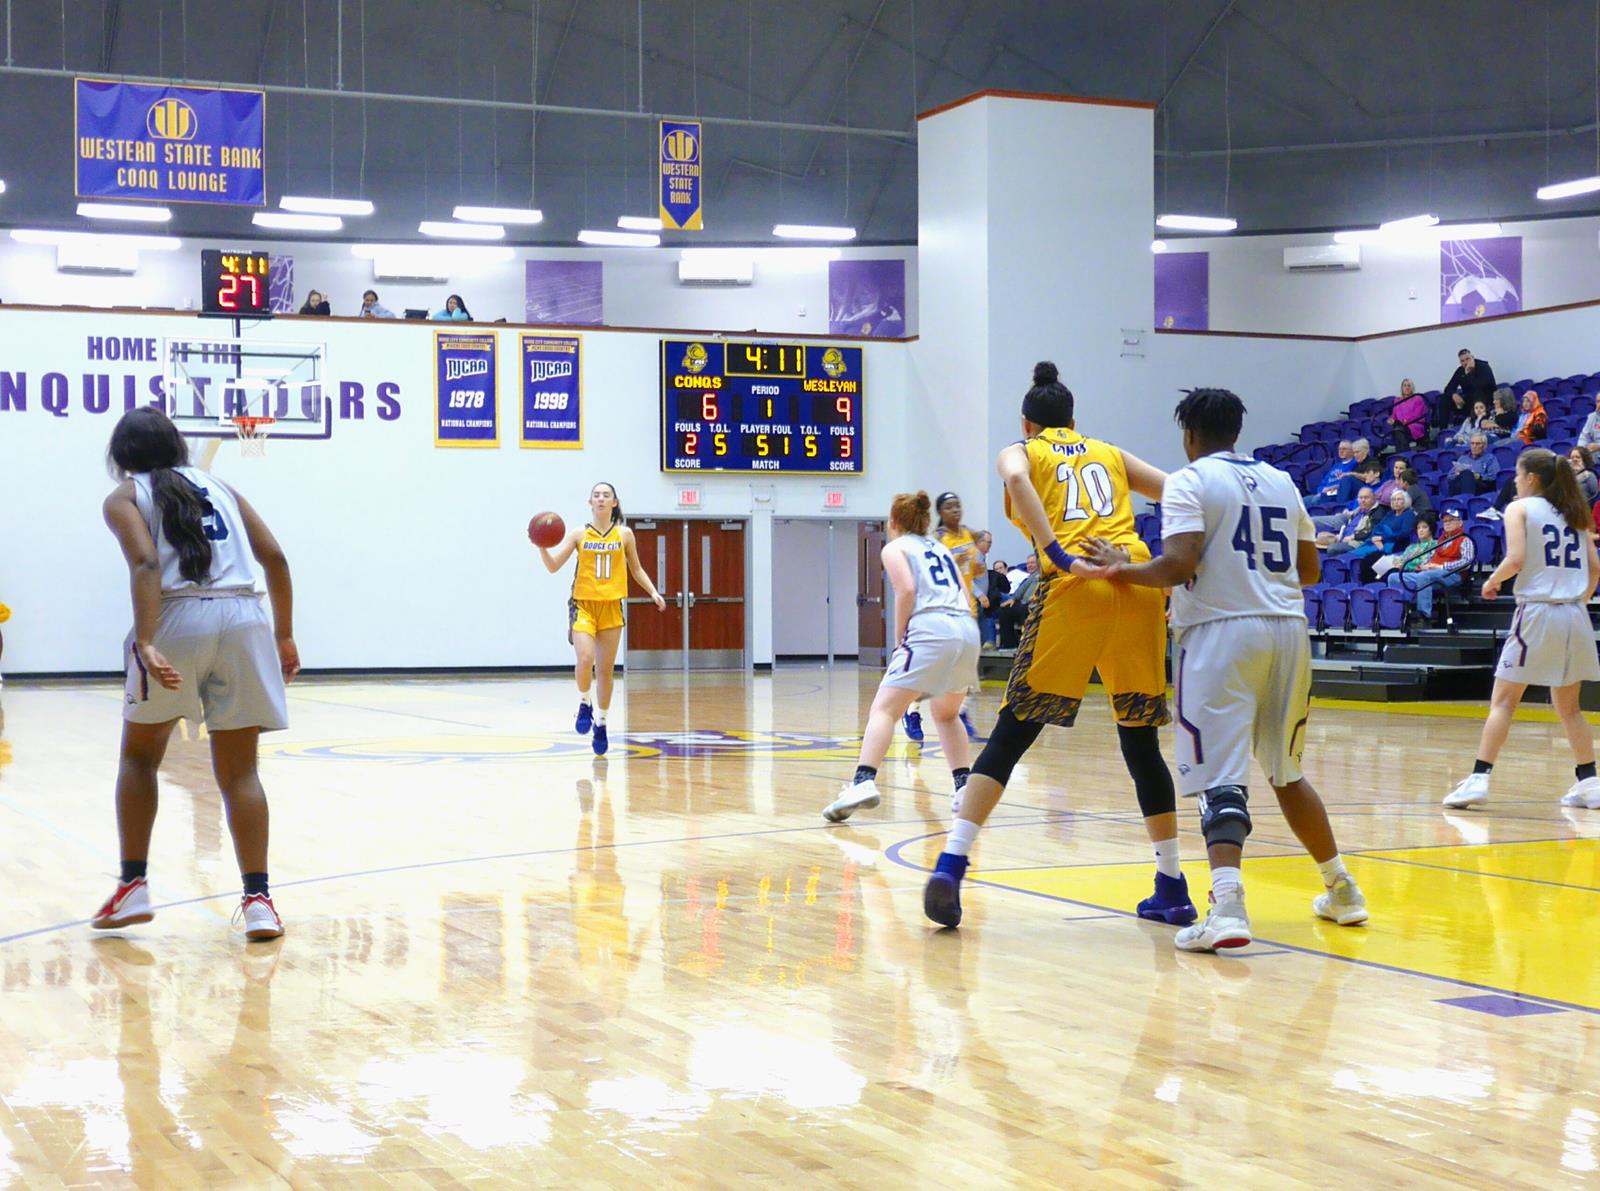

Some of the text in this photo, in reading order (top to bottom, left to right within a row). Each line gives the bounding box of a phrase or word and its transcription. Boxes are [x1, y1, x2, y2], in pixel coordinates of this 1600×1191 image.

[80, 137, 262, 169] WESTERN STATE BANK
[662, 163, 699, 176] WESTERN
[117, 168, 228, 193] CONQ LOUNGE
[669, 177, 693, 190] STATE
[670, 191, 692, 204] BANK
[222, 255, 266, 274] 4:11
[219, 274, 257, 308] 27
[87, 336, 157, 362] HOME
[746, 346, 802, 372] 4:11
[446, 358, 488, 380] NJCAA
[531, 360, 572, 383] NJCAA
[675, 375, 722, 389] CONQS
[751, 386, 780, 395] PERIOD
[804, 379, 857, 393] WESLEYAN
[449, 390, 485, 409] 1978
[534, 392, 569, 410] 1998
[702, 393, 718, 421] 6
[766, 399, 772, 418] 1
[836, 396, 851, 422] 9
[675, 423, 701, 432] FOULS
[709, 424, 731, 433] T.O.L.
[740, 424, 792, 435] PLAYER FOUL
[800, 425, 822, 435] T.O.L.
[830, 426, 855, 436] FOULS
[685, 433, 697, 455] 2
[714, 433, 727, 456] 5
[756, 435, 769, 456] 5
[804, 436, 817, 457] 5
[840, 437, 851, 458] 3
[675, 459, 701, 469] SCORE
[752, 460, 780, 470] MATCH
[830, 461, 855, 471] SCORE
[682, 490, 697, 504] EXIT
[828, 491, 842, 505] EXIT
[1056, 462, 1115, 521] 20
[1231, 504, 1291, 573] 45
[1542, 524, 1581, 569] 22
[595, 553, 611, 579] 11
[924, 550, 961, 592] 21
